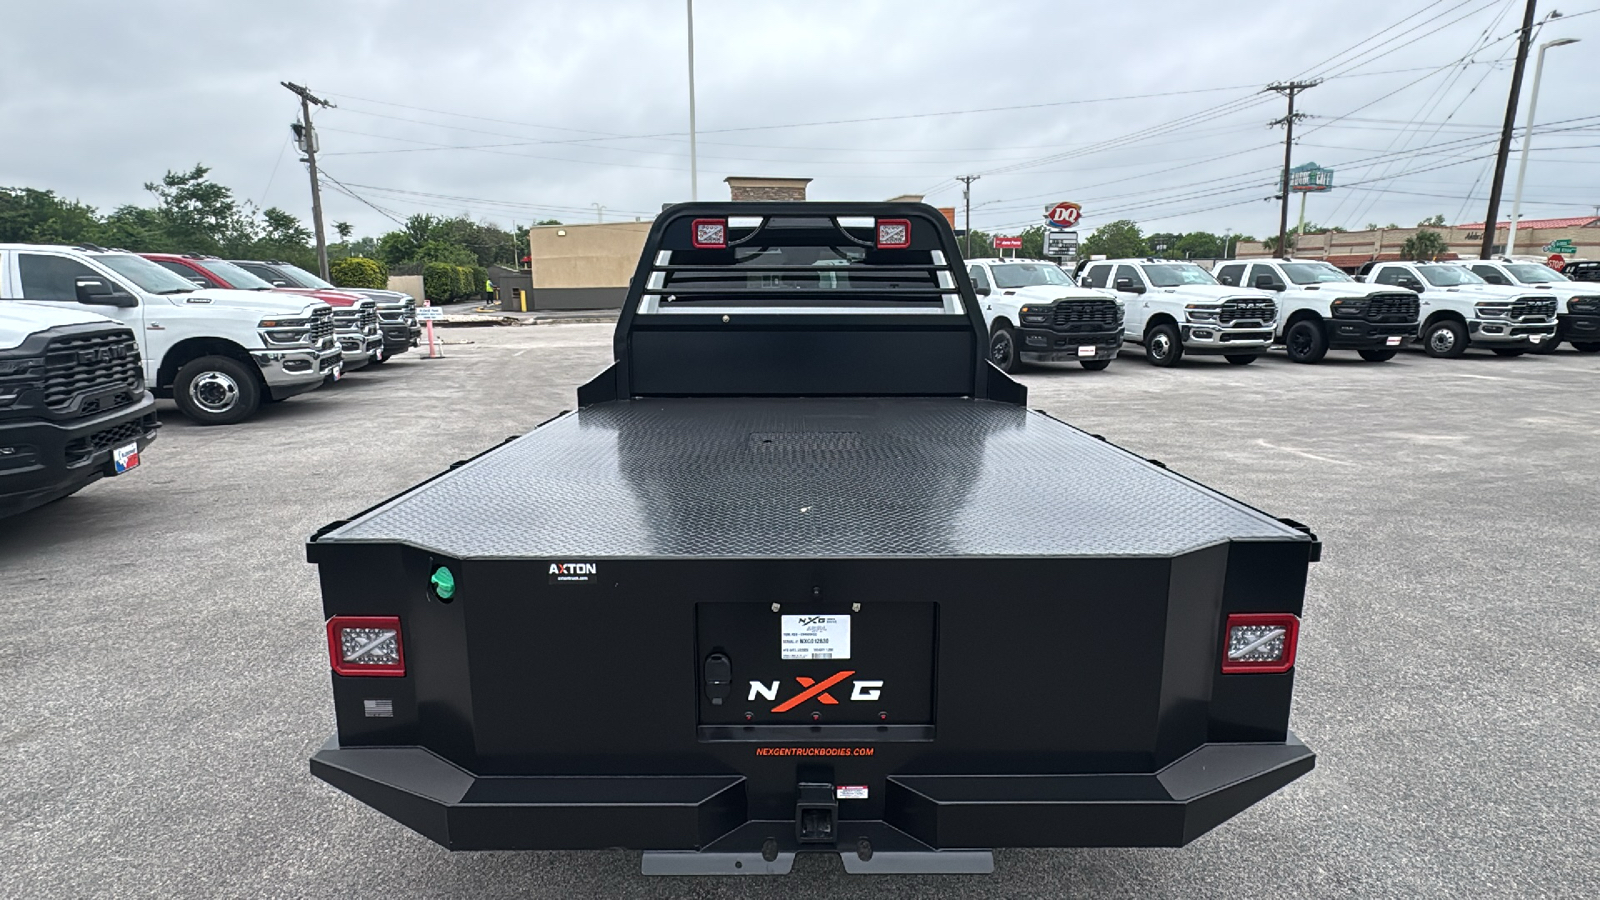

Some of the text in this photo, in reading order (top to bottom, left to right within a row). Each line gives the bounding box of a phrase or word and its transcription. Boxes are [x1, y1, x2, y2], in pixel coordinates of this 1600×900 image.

[1053, 207, 1077, 223] DQ
[1548, 259, 1565, 269] STOP
[549, 563, 597, 574] AXTON
[798, 615, 825, 626] NXG
[747, 670, 884, 713] NXG
[756, 747, 875, 757] NEXGENTRUCKBODIES.COM
